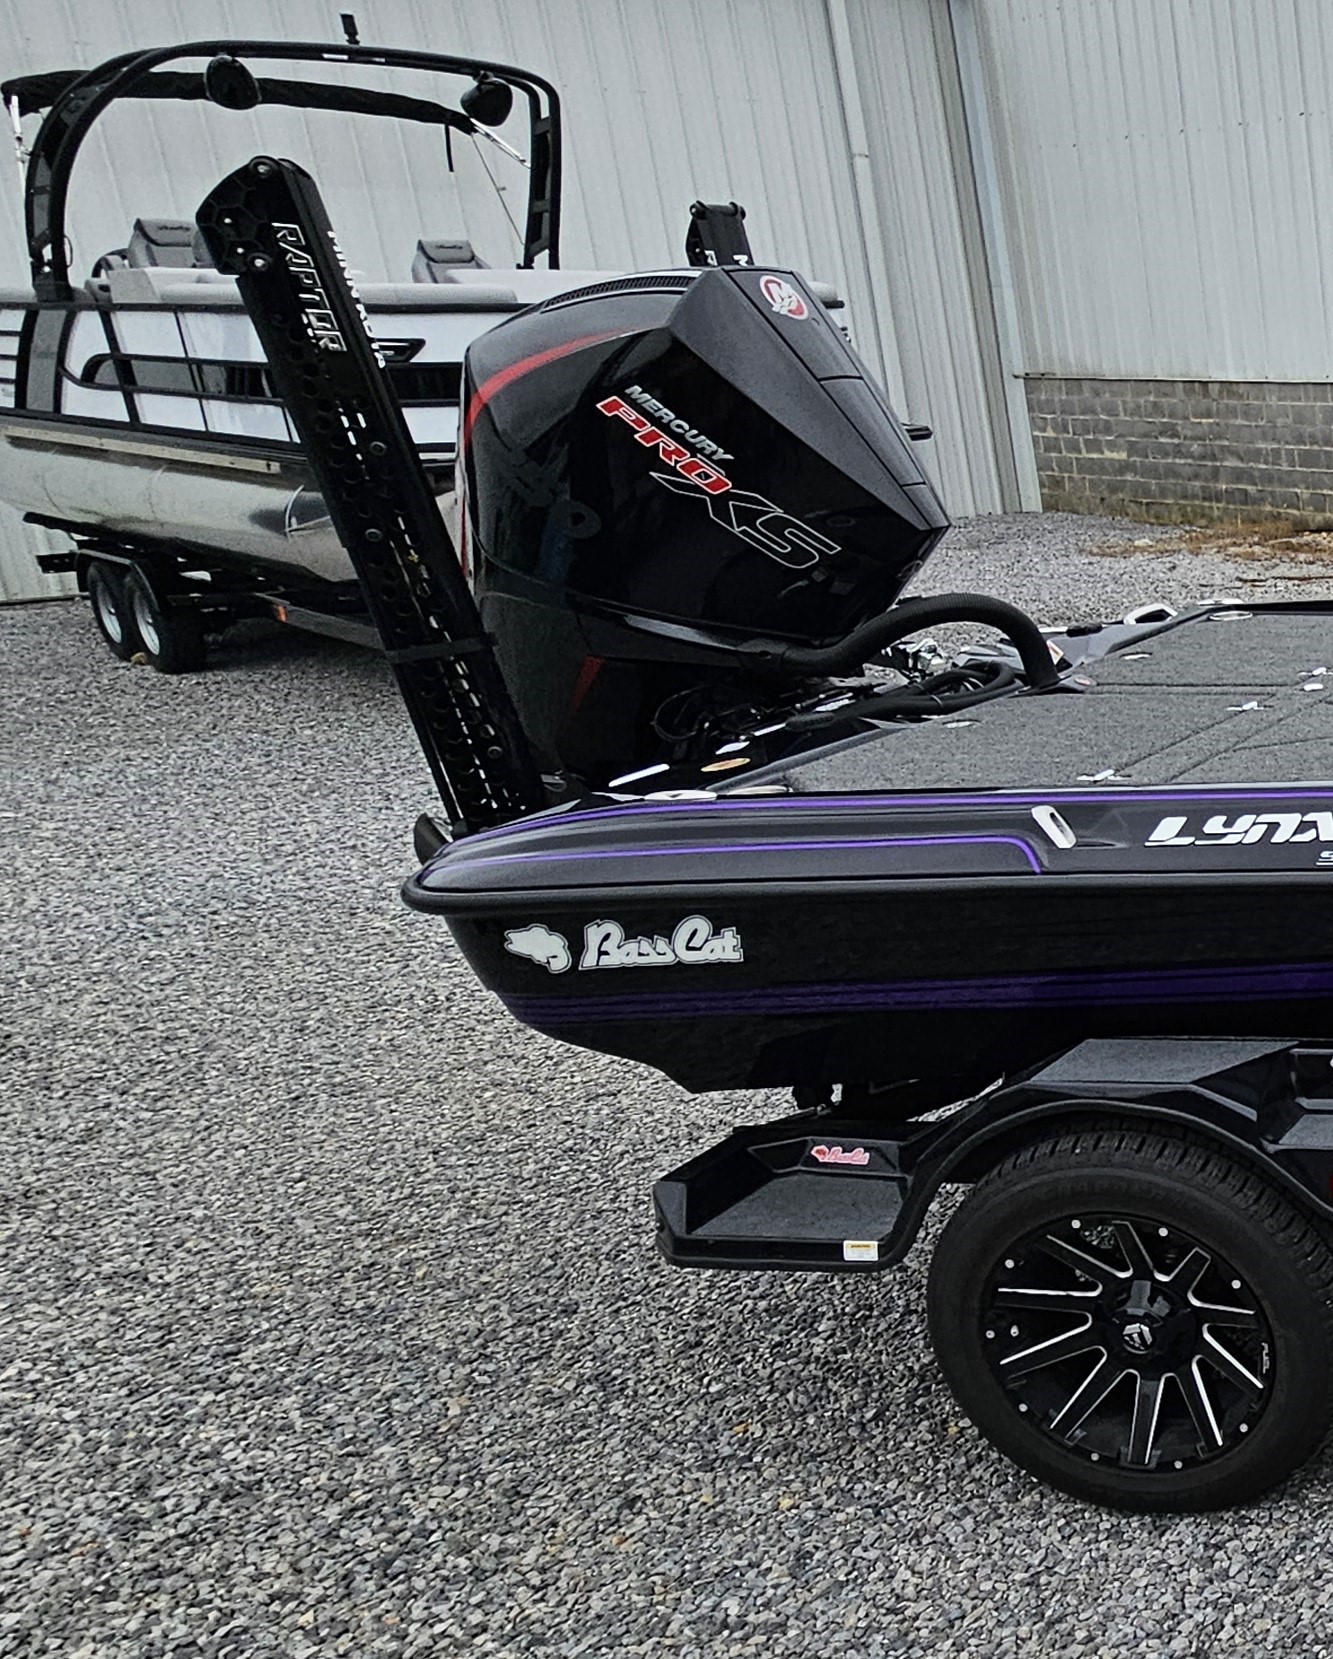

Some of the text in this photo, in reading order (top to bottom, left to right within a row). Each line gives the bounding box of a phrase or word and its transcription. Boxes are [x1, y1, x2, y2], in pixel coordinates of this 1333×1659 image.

[271, 222, 347, 351] RAPTOR
[596, 395, 842, 569] PRO XS
[624, 384, 735, 461] MERCURY
